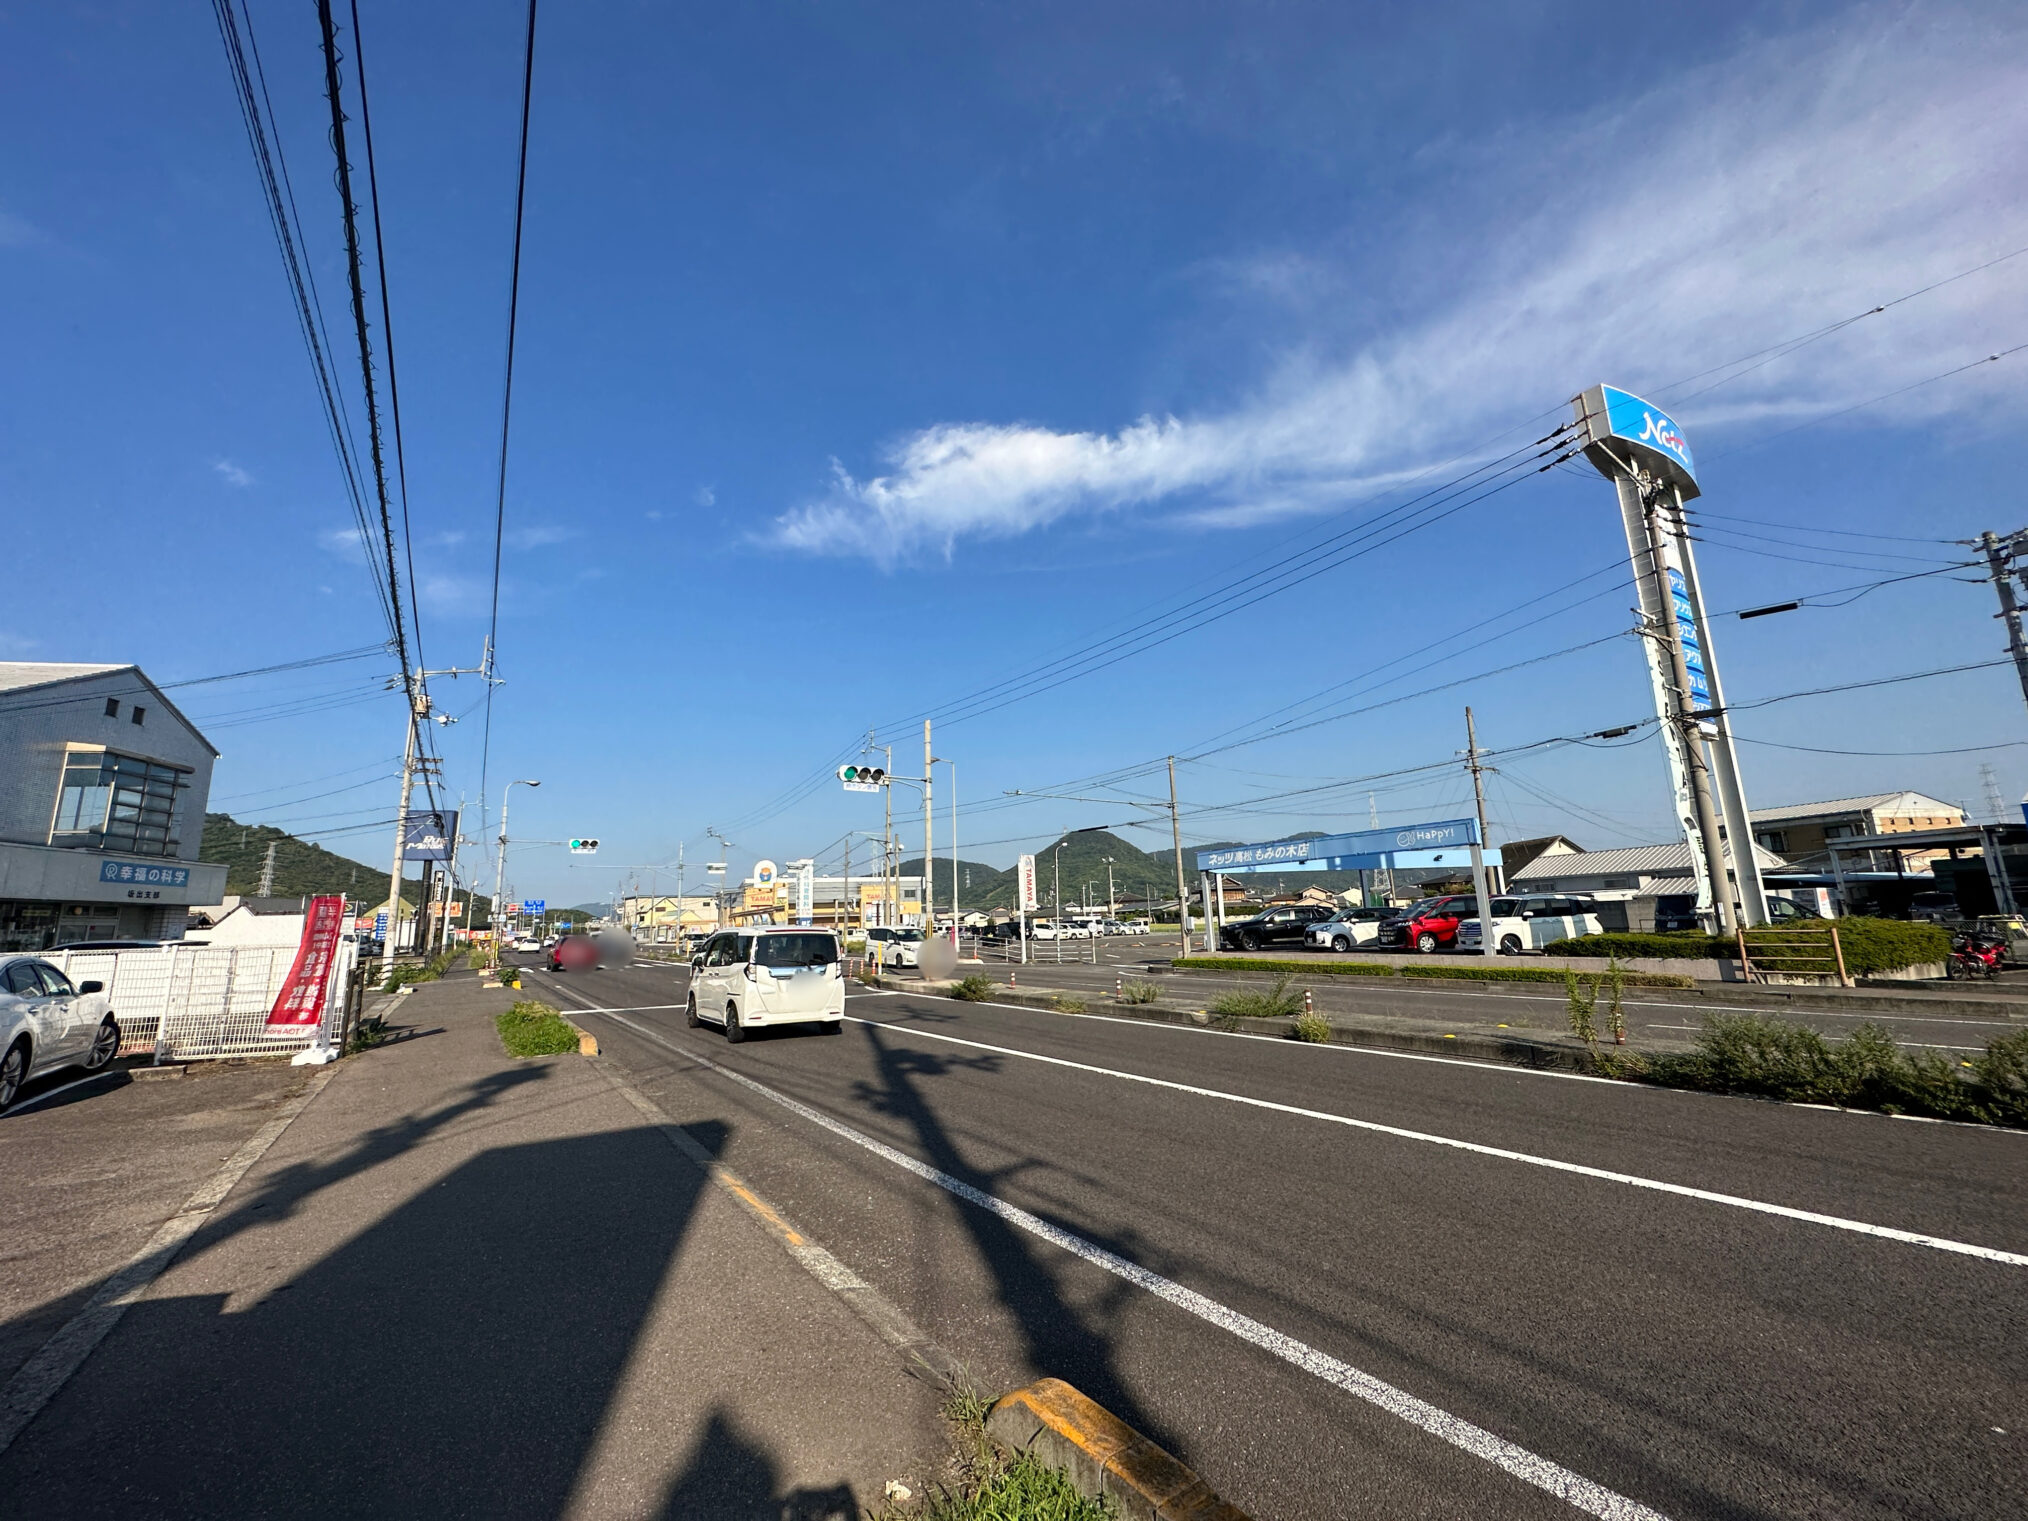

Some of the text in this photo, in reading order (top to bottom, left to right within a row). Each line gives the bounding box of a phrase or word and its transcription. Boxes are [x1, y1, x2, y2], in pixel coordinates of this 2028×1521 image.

[1638, 411, 1688, 464] Netz
[1255, 843, 1310, 860] もみの木店
[120, 866, 186, 883] 幸福の科学
